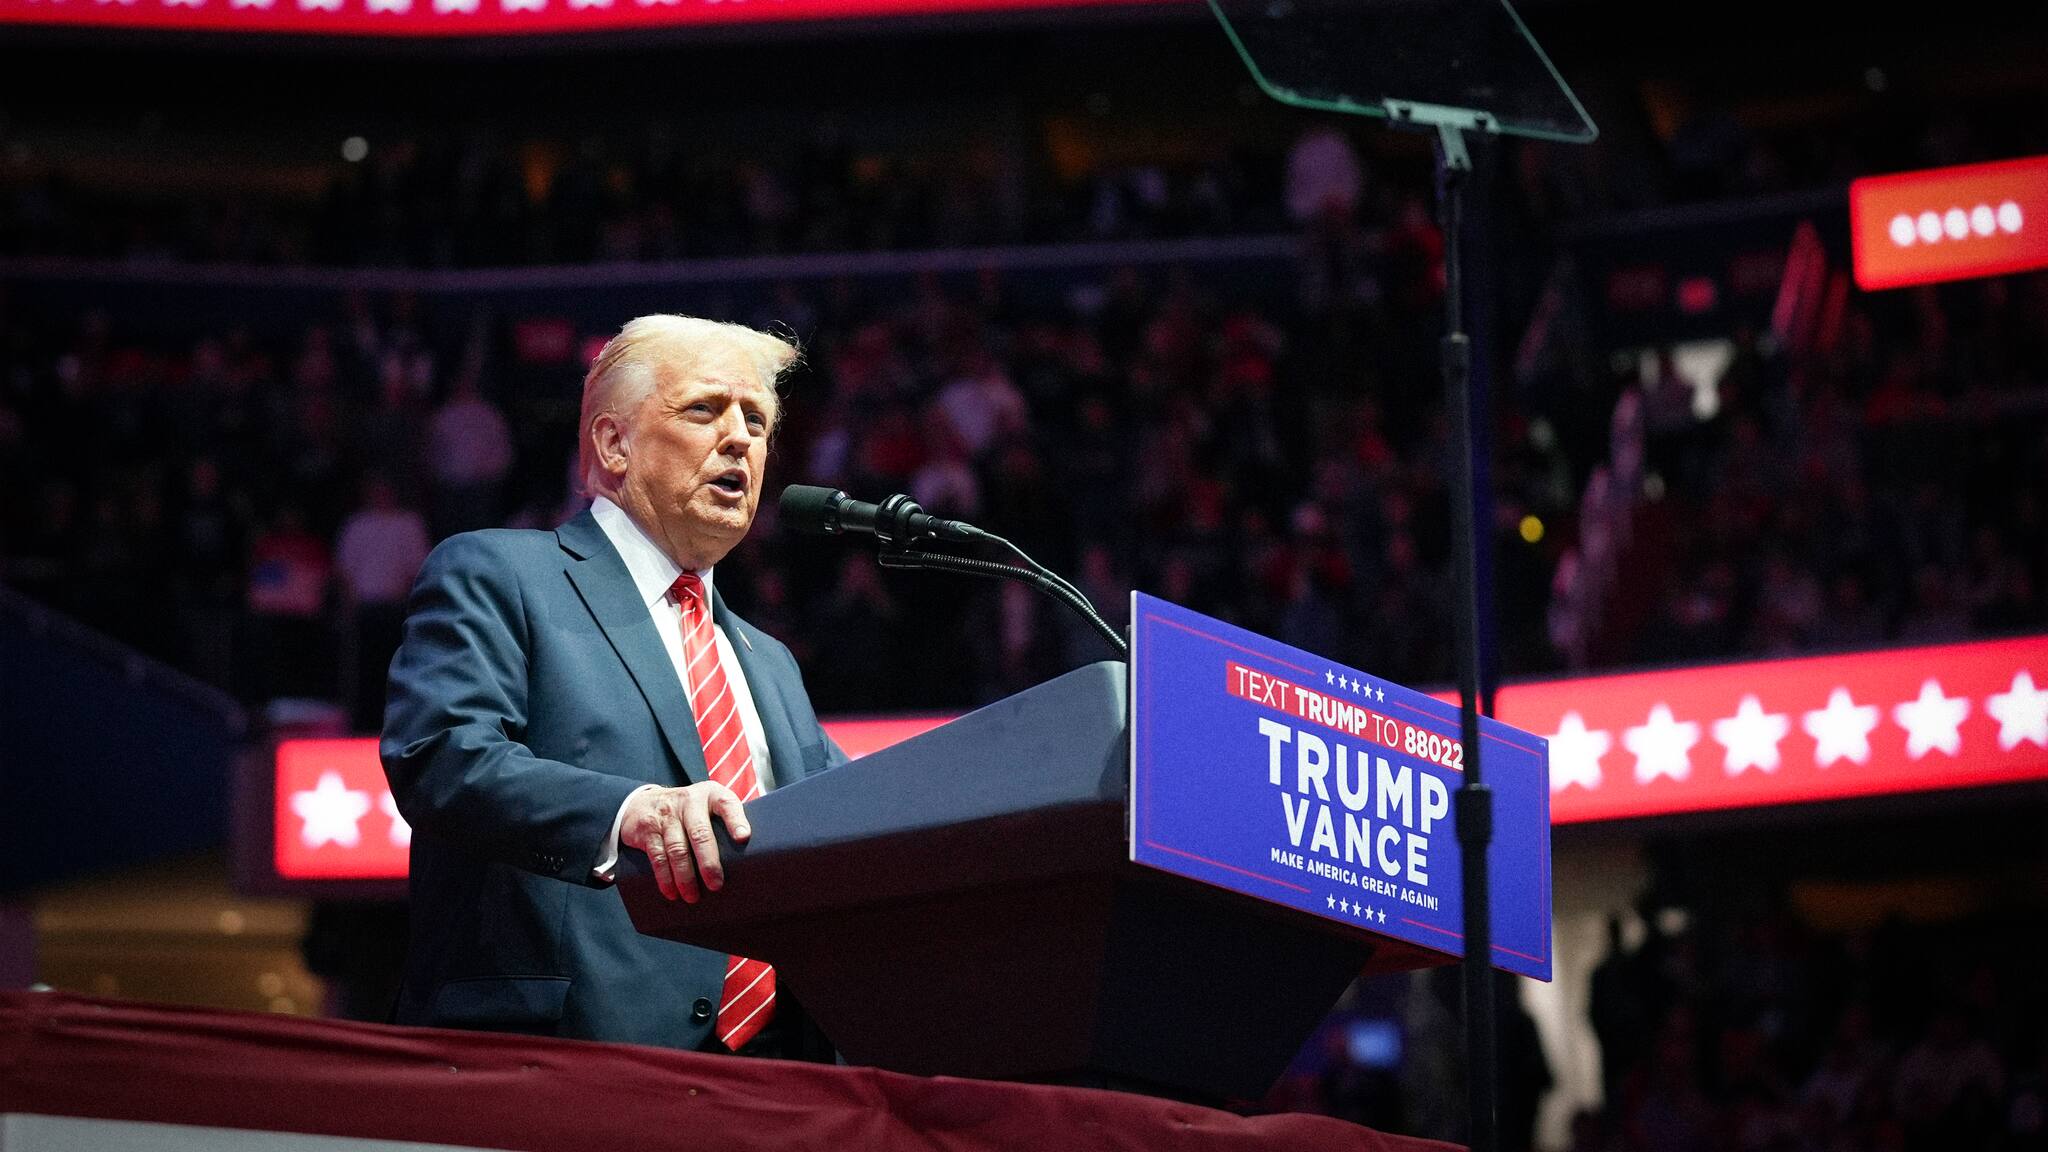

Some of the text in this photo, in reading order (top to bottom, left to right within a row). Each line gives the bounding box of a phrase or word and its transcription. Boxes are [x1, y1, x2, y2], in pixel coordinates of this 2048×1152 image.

[1235, 665, 1464, 771] TEXT TRUMP TO 88022
[1258, 716, 1449, 835] TRUMP
[1270, 847, 1439, 912] MAKE AMERICA GREAT AGAIN!
[1280, 791, 1429, 887] VANCE
